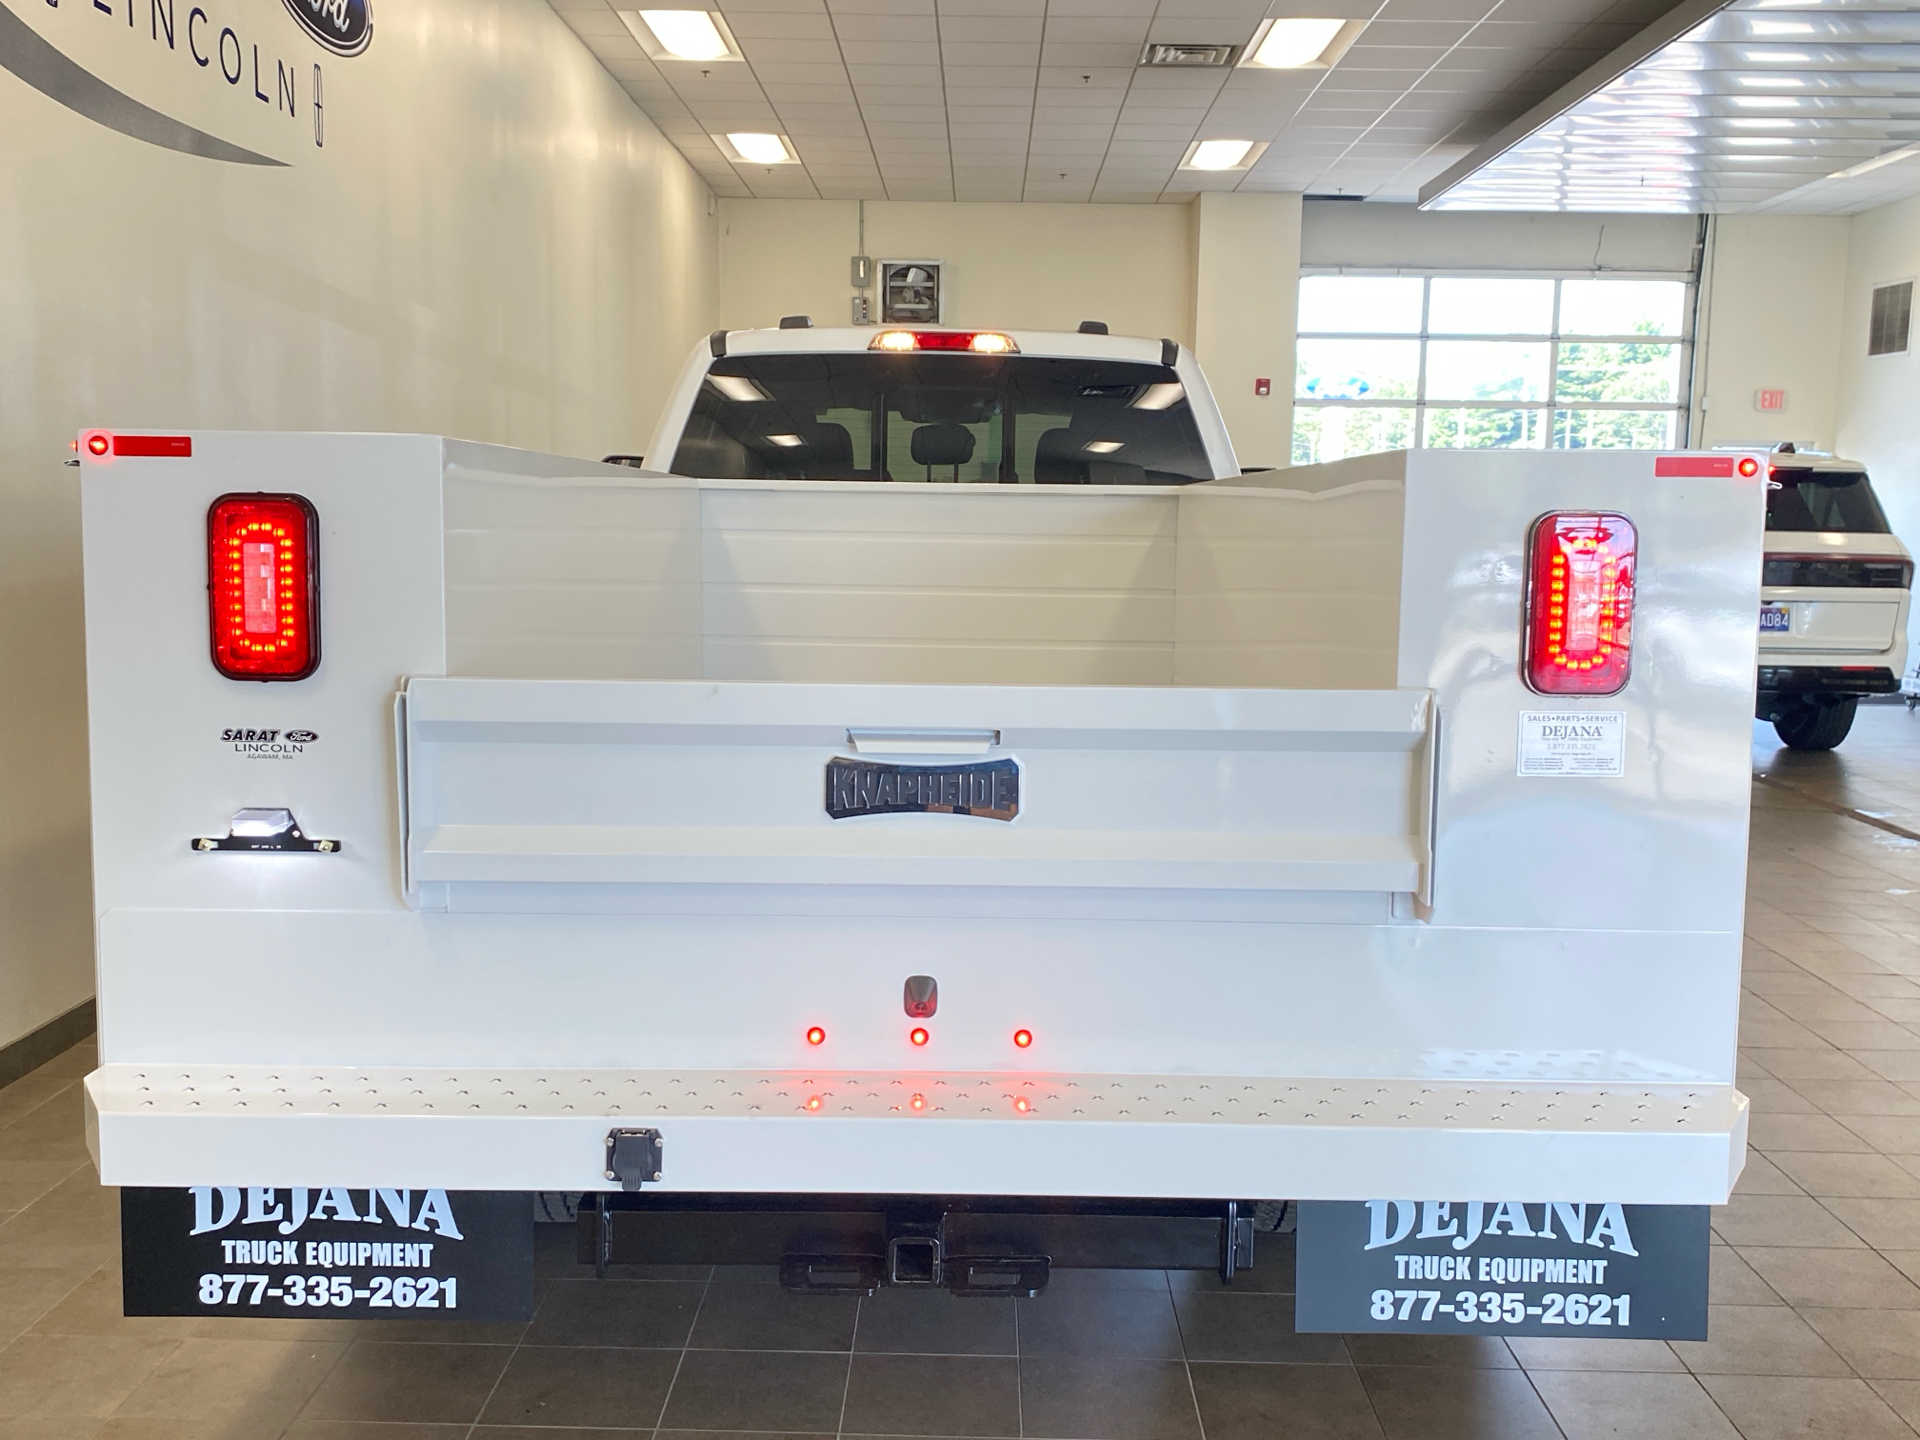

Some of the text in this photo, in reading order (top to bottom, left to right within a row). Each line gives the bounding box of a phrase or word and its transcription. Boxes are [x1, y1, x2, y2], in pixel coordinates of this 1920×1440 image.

[93, 0, 295, 118] NCOLN
[1761, 390, 1785, 409] EXIT
[220, 728, 315, 743] SARAT Ford
[234, 743, 303, 753] LINCOLN
[1541, 725, 1603, 740] DEJANA
[833, 766, 1012, 811] KNAPHEIDE
[189, 1186, 464, 1240] DEJANA
[1364, 1200, 1639, 1257] DEJANA
[221, 1240, 434, 1268] TRUCK EQUIPMENT
[1394, 1255, 1608, 1284] TRUCK EQUIPMENT
[198, 1274, 457, 1308] 877-335-2621
[1370, 1289, 1631, 1326] 877-335-2621
